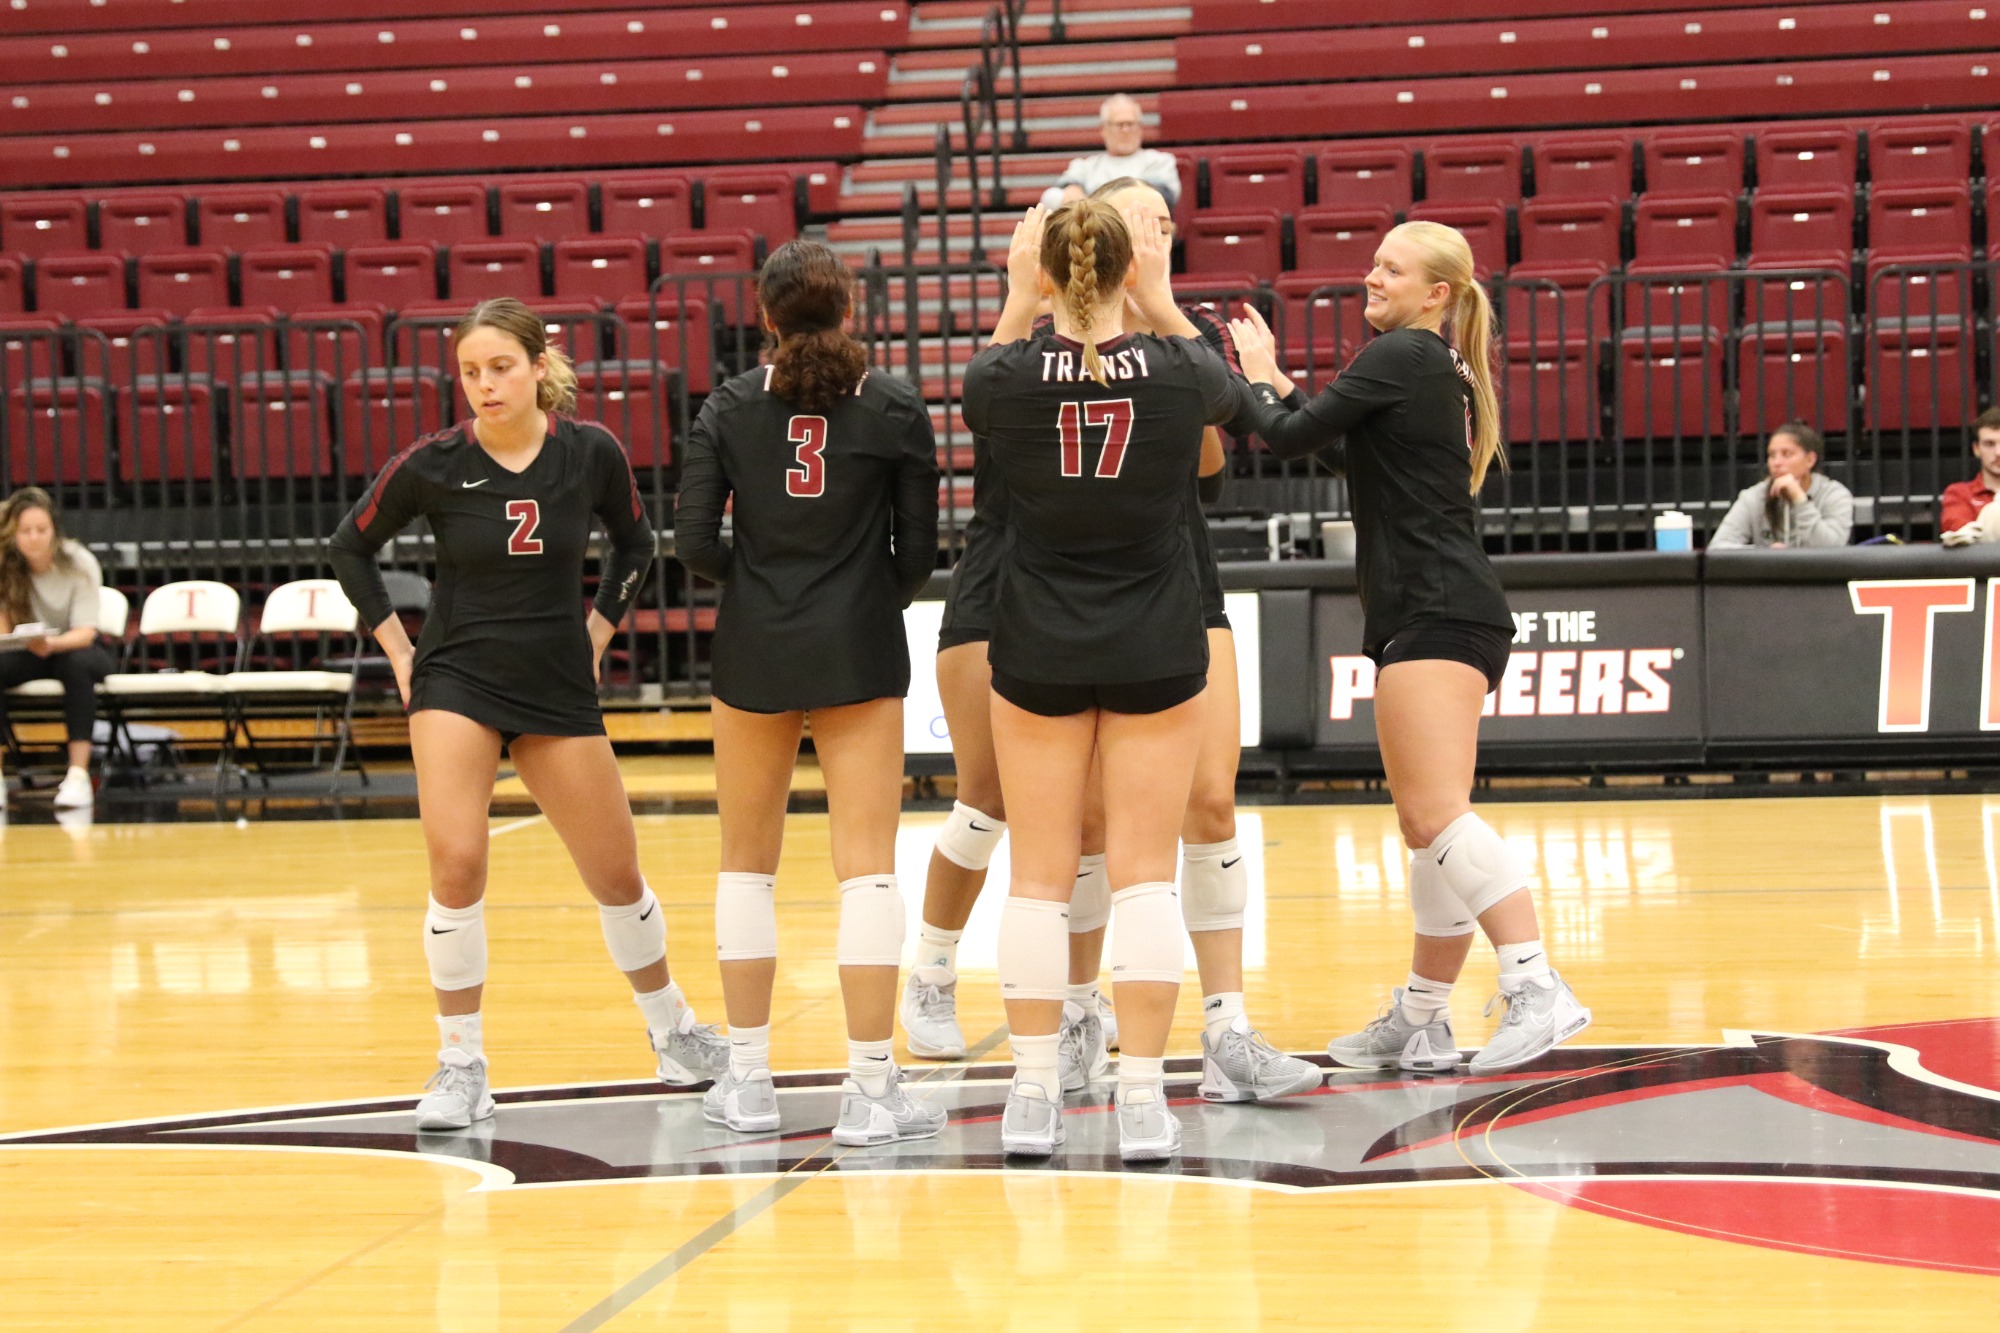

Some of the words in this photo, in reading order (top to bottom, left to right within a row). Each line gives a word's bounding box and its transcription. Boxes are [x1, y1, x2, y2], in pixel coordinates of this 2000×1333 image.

[786, 414, 828, 497] 3
[1057, 398, 1134, 478] 17
[505, 499, 543, 555] 2
[176, 587, 207, 619] T
[299, 587, 328, 618] T
[1543, 610, 1597, 642] THE
[1329, 648, 1673, 720] PEERS
[1847, 577, 2000, 733] T
